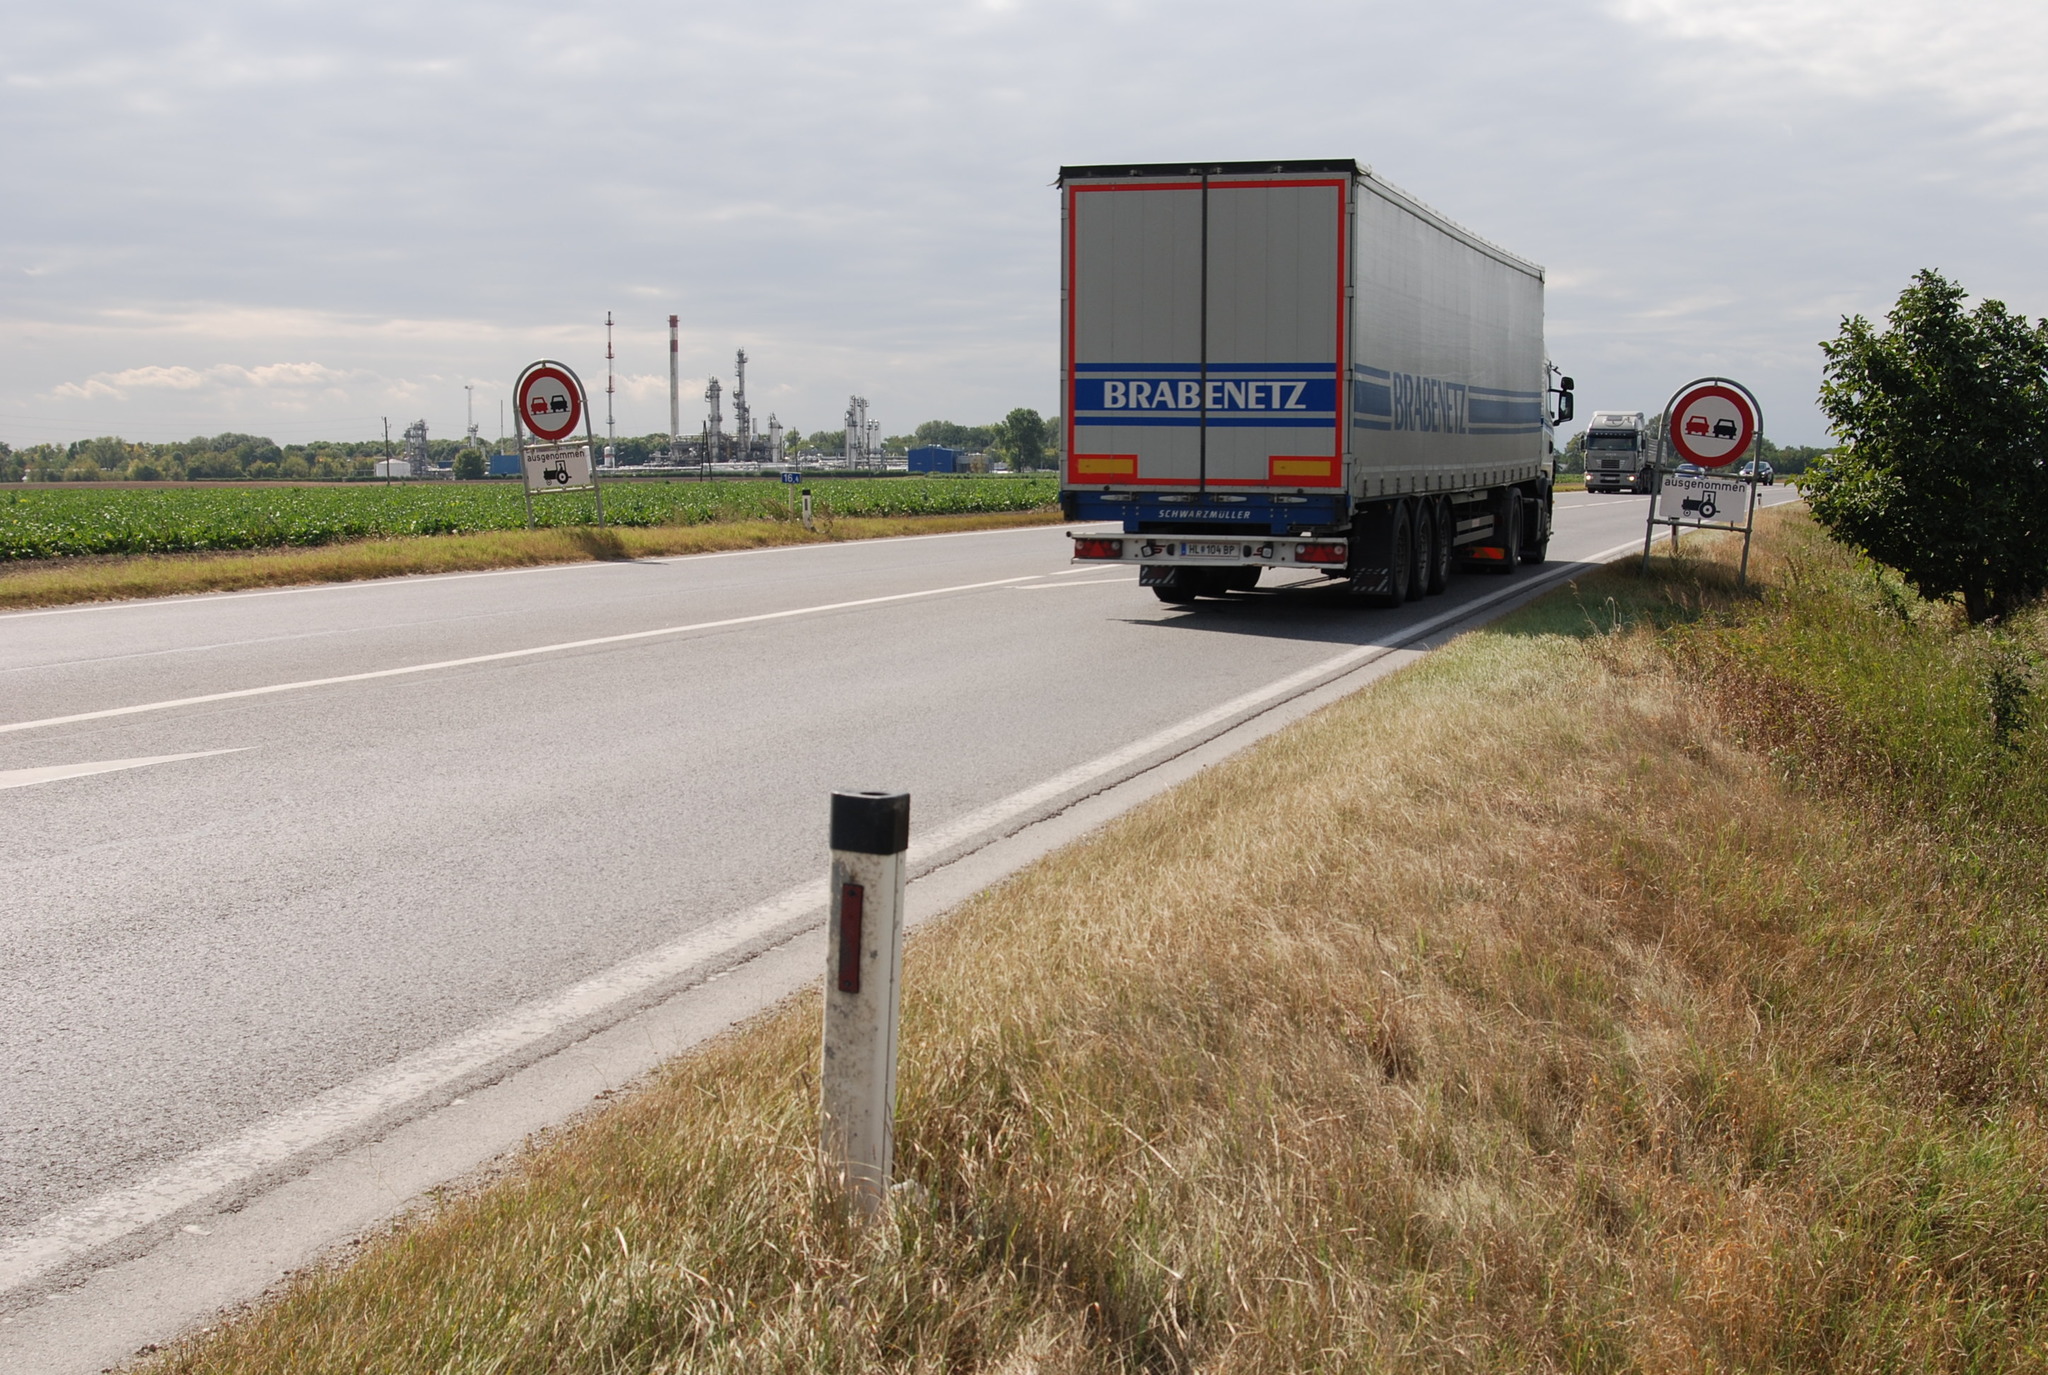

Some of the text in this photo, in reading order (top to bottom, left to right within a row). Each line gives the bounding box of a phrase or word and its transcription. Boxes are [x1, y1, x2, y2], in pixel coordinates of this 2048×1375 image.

[1103, 381, 1307, 409] BRABENETZ
[1393, 372, 1466, 434] BRABENETZ
[527, 450, 585, 463] ausgenommen
[1664, 477, 1745, 492] ausgenommen
[1158, 509, 1251, 519] SCHWARZMÜLLER
[1188, 545, 1200, 554] HL
[1206, 545, 1221, 554] 104
